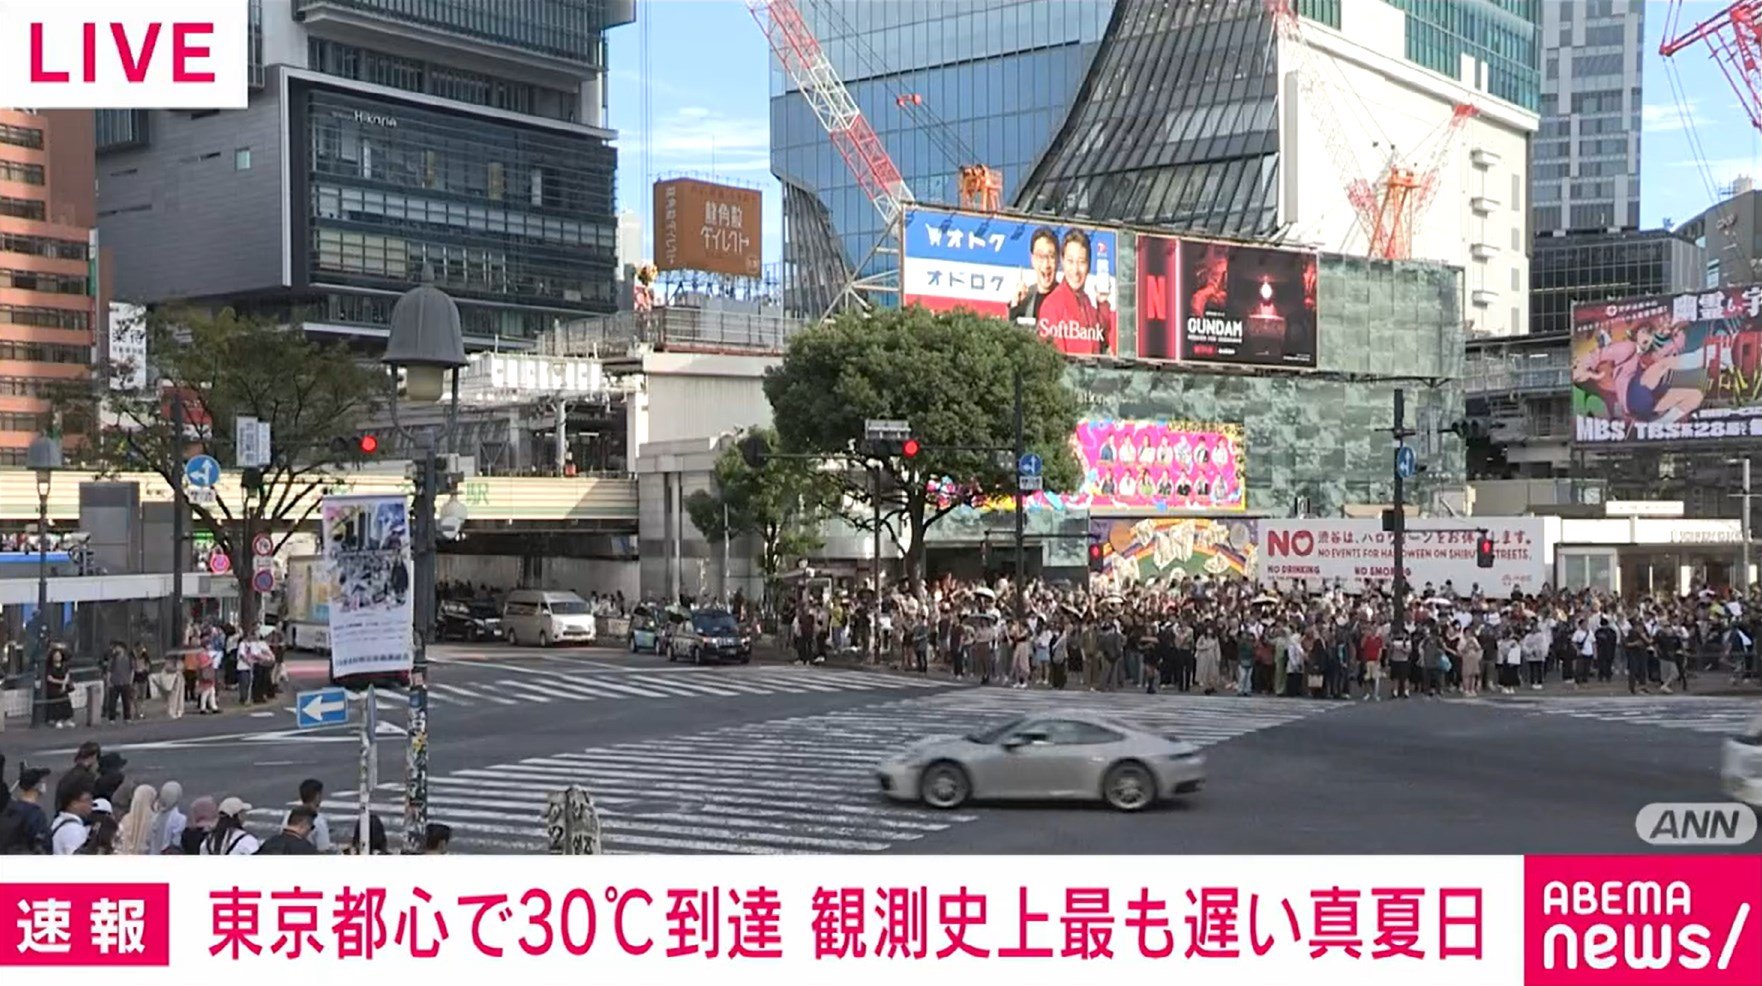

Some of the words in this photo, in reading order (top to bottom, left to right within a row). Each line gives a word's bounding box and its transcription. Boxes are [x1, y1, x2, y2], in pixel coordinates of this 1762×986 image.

[927, 270, 1005, 292] オドロク
[1146, 275, 1166, 321] N
[1039, 317, 1106, 343] SoftBank
[1187, 318, 1243, 337] GUNDAM
[1267, 529, 1314, 557] NO
[1317, 548, 1330, 558] NO
[1331, 548, 1361, 559] EVENTS
[1363, 549, 1379, 558] FOR
[1433, 549, 1447, 559] ON
[1267, 564, 1281, 575] NO
[1281, 565, 1321, 576] DRINKING
